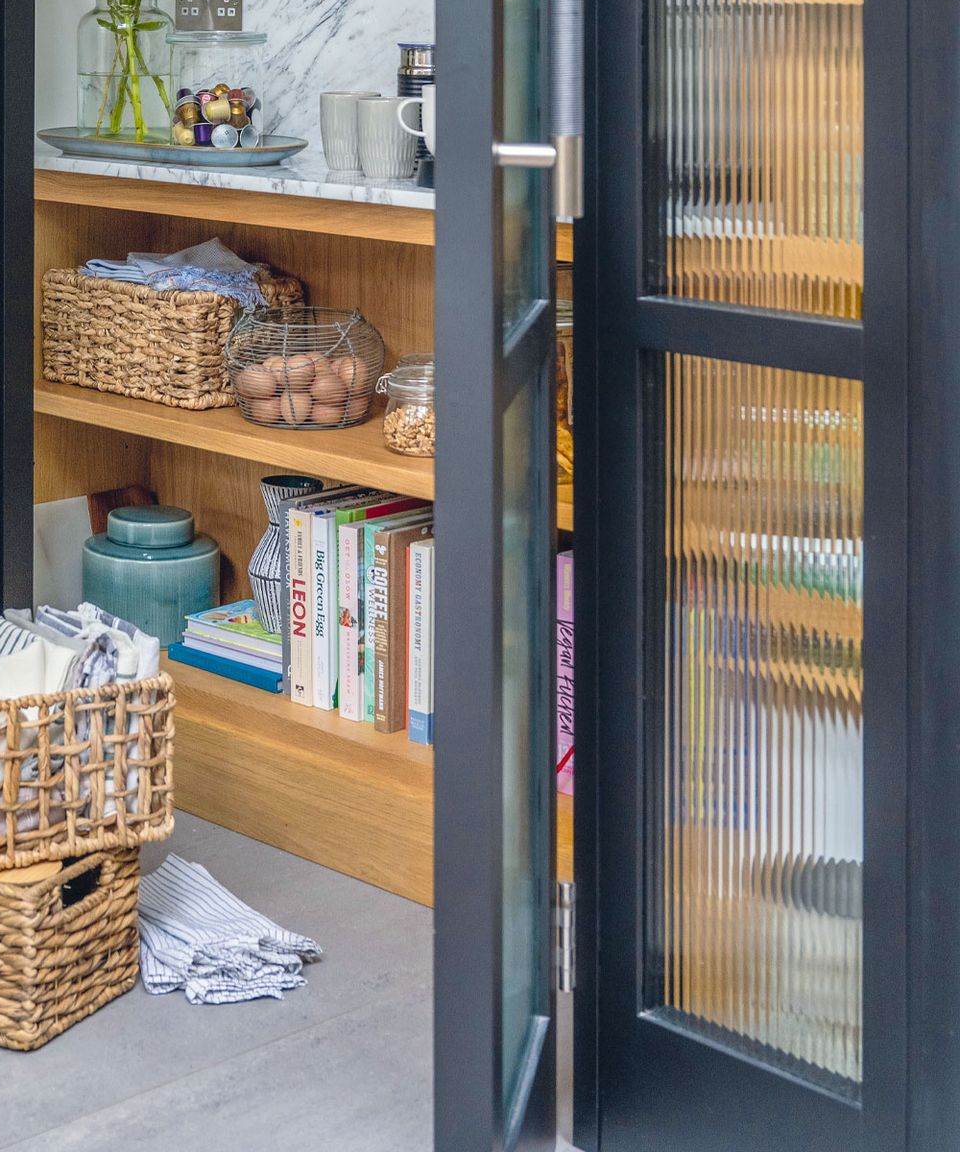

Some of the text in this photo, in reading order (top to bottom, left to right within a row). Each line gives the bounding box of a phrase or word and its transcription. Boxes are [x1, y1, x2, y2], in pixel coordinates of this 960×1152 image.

[314, 549, 326, 571] Big
[414, 552, 422, 592] ECONOMY
[292, 578, 306, 638] LEON
[316, 573, 326, 611] Green
[374, 566, 388, 621] COFFEE
[315, 613, 326, 638] Egg
[368, 589, 376, 644] WELLNESS
[414, 594, 422, 652] GASTRONOMY
